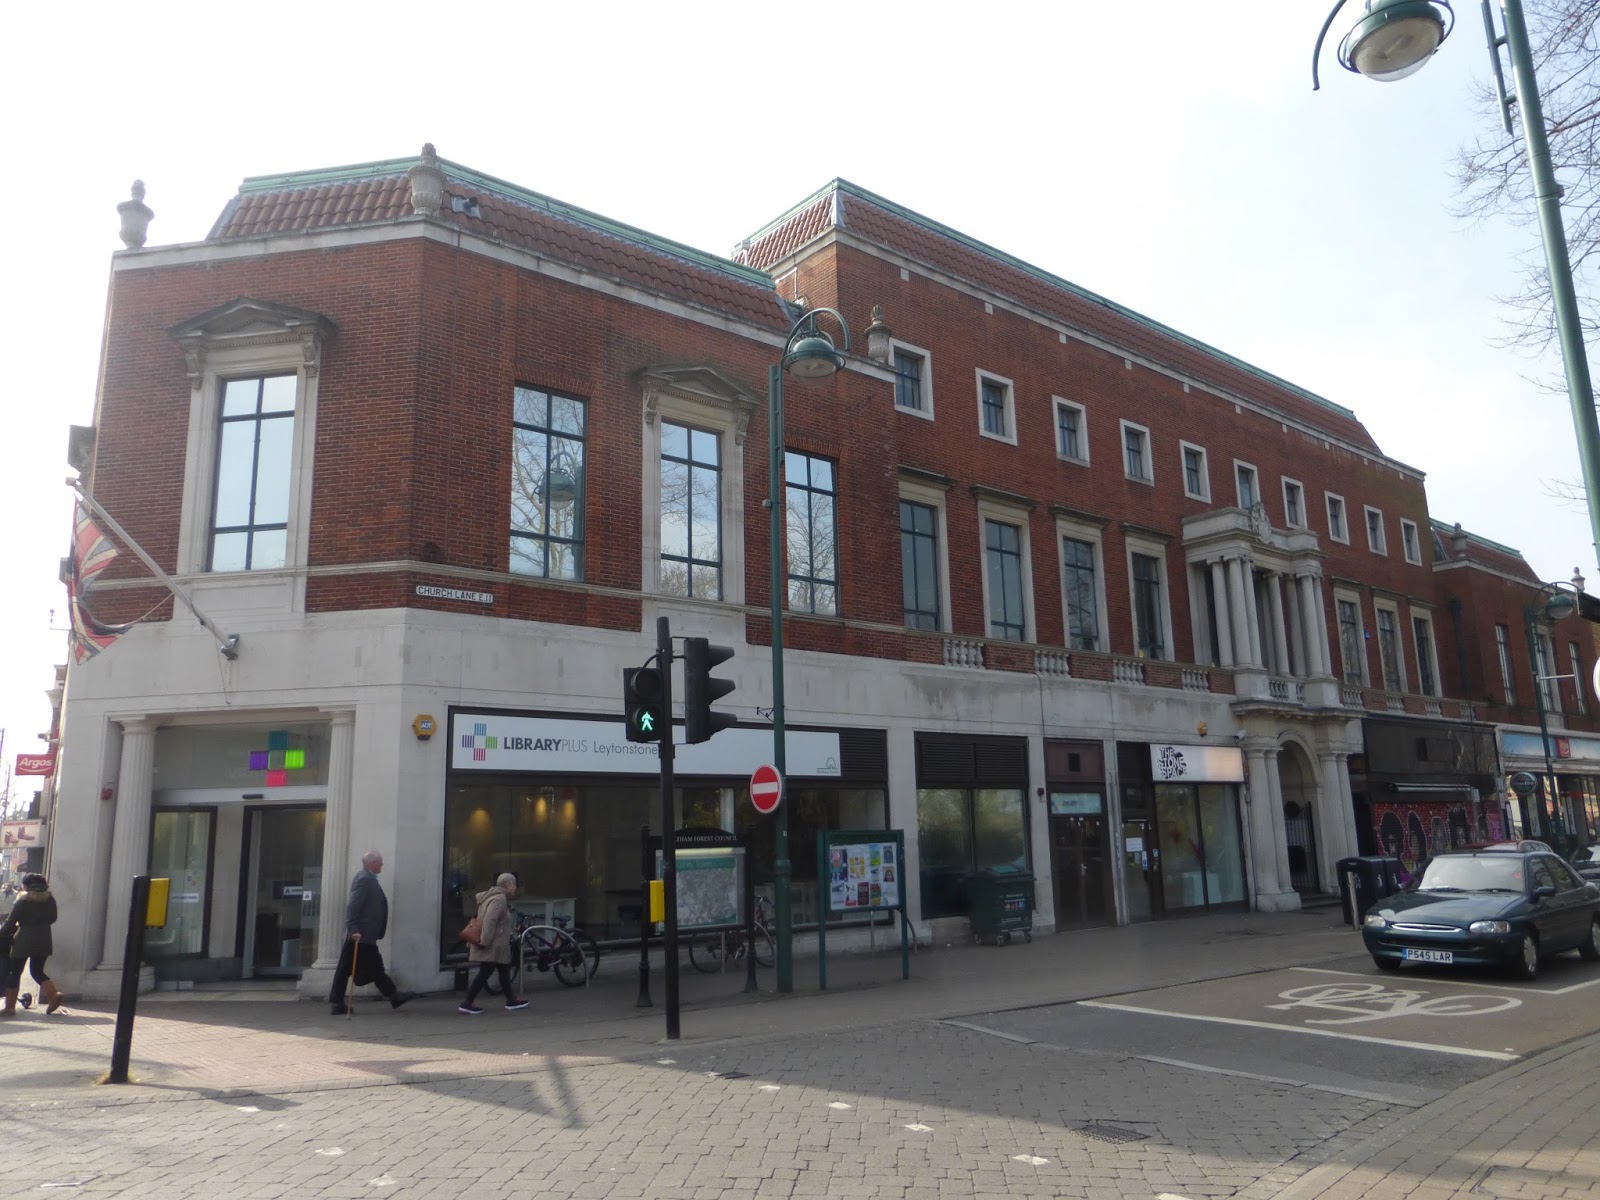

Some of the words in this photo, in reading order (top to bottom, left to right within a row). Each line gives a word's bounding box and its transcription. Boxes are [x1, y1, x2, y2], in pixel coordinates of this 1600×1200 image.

[418, 586, 453, 598] CHURCH
[454, 590, 477, 600] LANE
[503, 736, 588, 753] LIBRARYPLUS
[593, 740, 658, 757] Leytonstone
[1159, 746, 1174, 758] THE
[19, 757, 53, 769] Argos
[1158, 757, 1186, 768] STONE
[1407, 949, 1431, 960] P545
[1432, 951, 1451, 961] LAR
